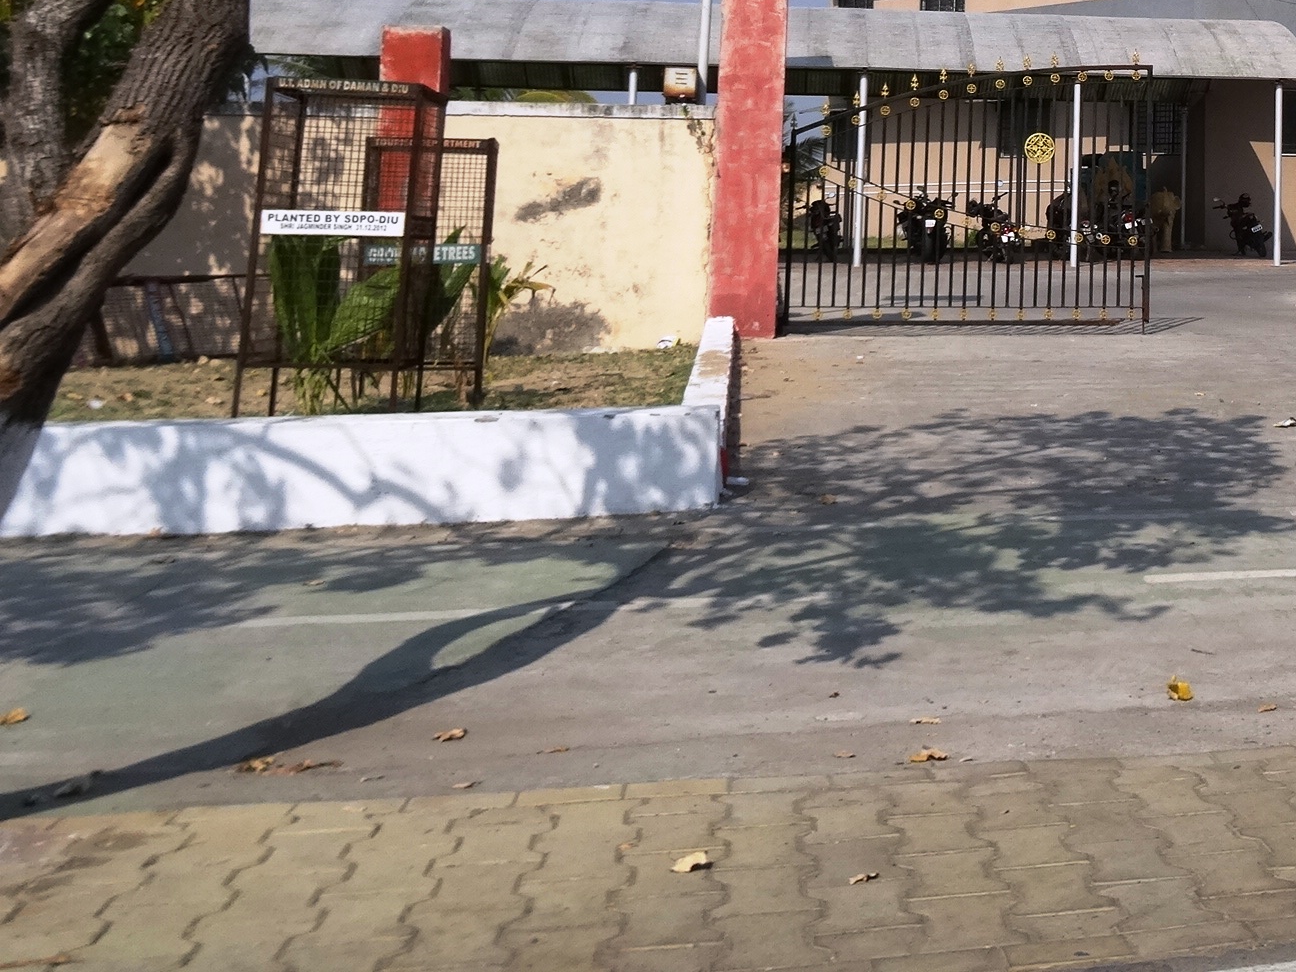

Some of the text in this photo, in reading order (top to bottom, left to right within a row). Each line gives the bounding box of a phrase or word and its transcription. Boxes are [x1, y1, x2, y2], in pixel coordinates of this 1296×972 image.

[328, 80, 343, 90] OF
[343, 81, 380, 92] DAMAN
[267, 213, 399, 224] PLANTED BY SDPO-DIU
[442, 245, 476, 261] TREES
